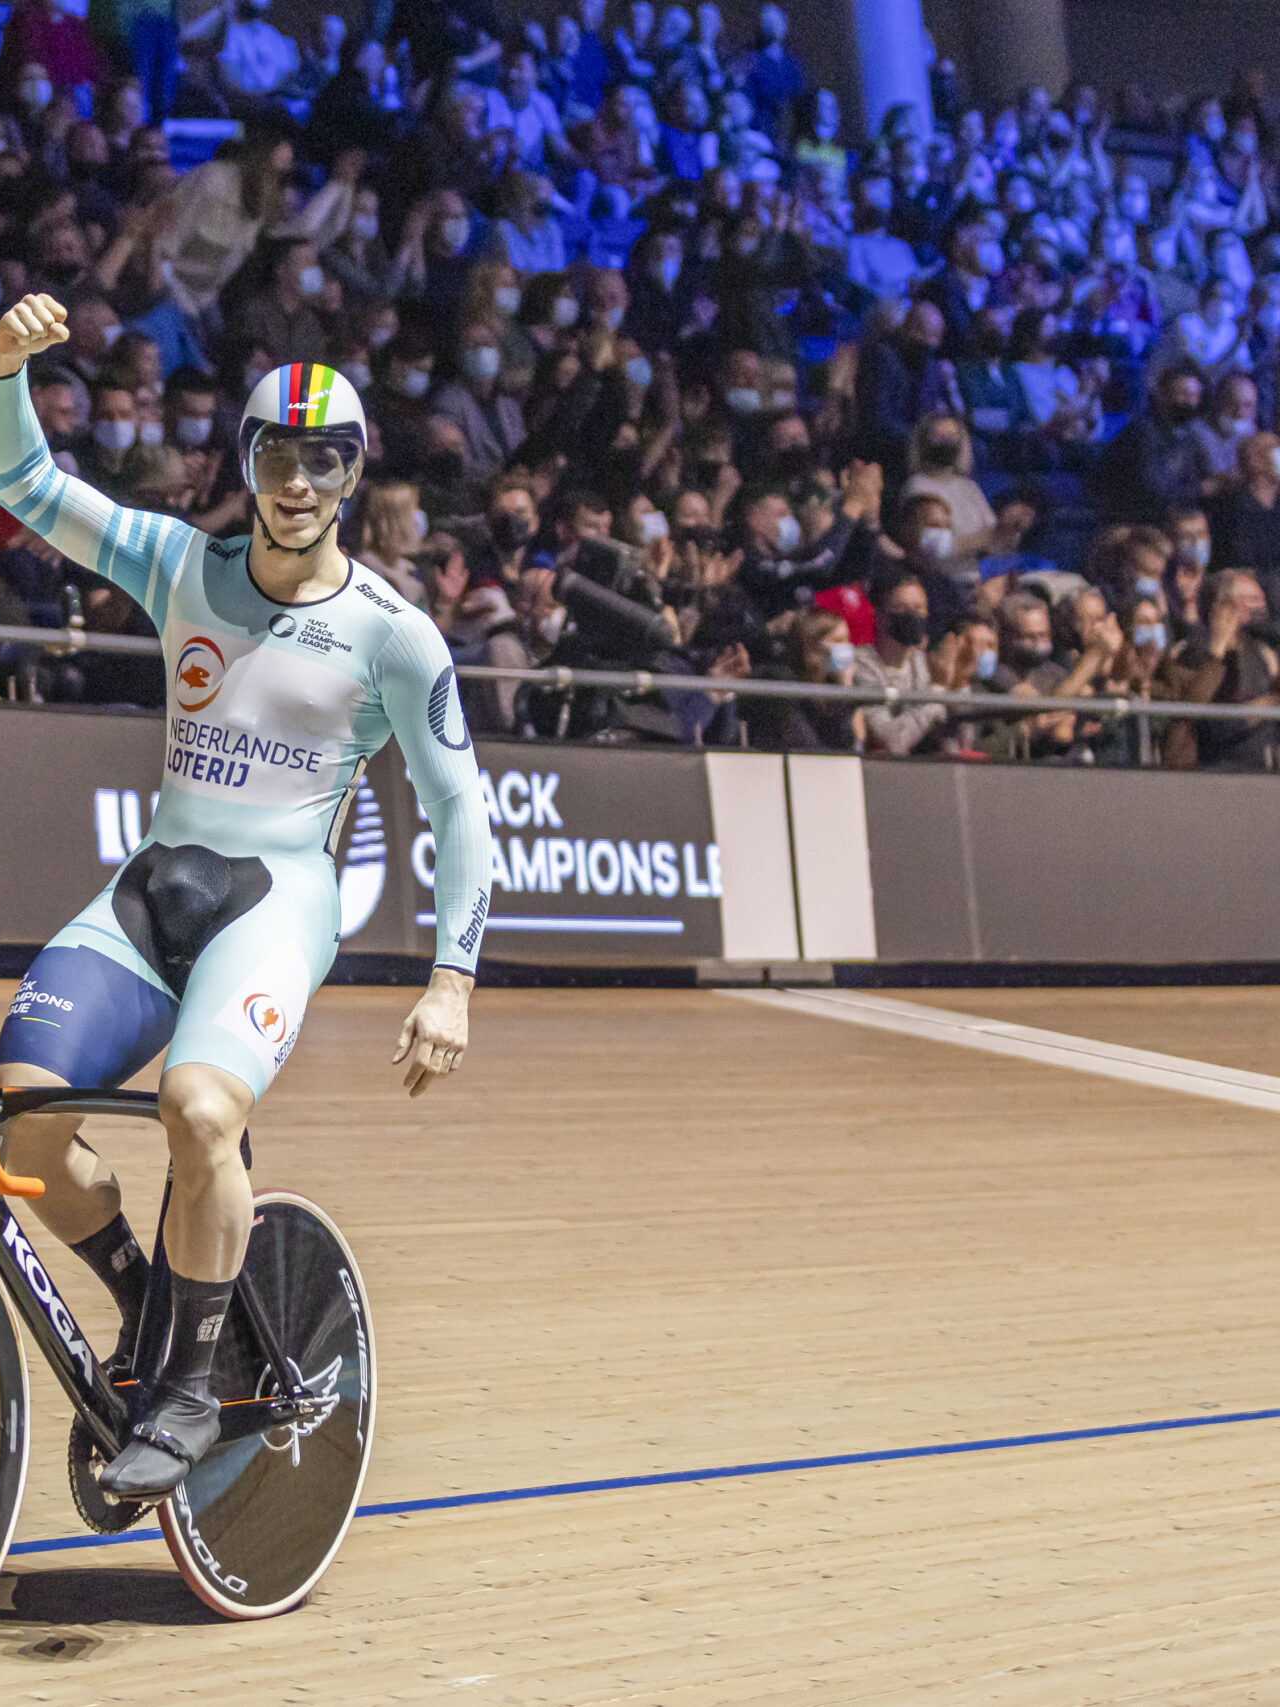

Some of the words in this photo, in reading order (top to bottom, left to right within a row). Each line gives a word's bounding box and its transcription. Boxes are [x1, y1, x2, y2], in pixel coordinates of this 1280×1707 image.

[355, 583, 405, 614] Santini
[304, 624, 335, 638] TRACK
[310, 619, 328, 629] UCI
[297, 636, 332, 653] LEAGUE
[300, 630, 353, 653] CHAMPIONS
[170, 716, 323, 773] NEDERLANDSE
[167, 743, 250, 788] LOTERIJ
[457, 887, 489, 955] Santini
[2, 1215, 94, 1387] KOGA
